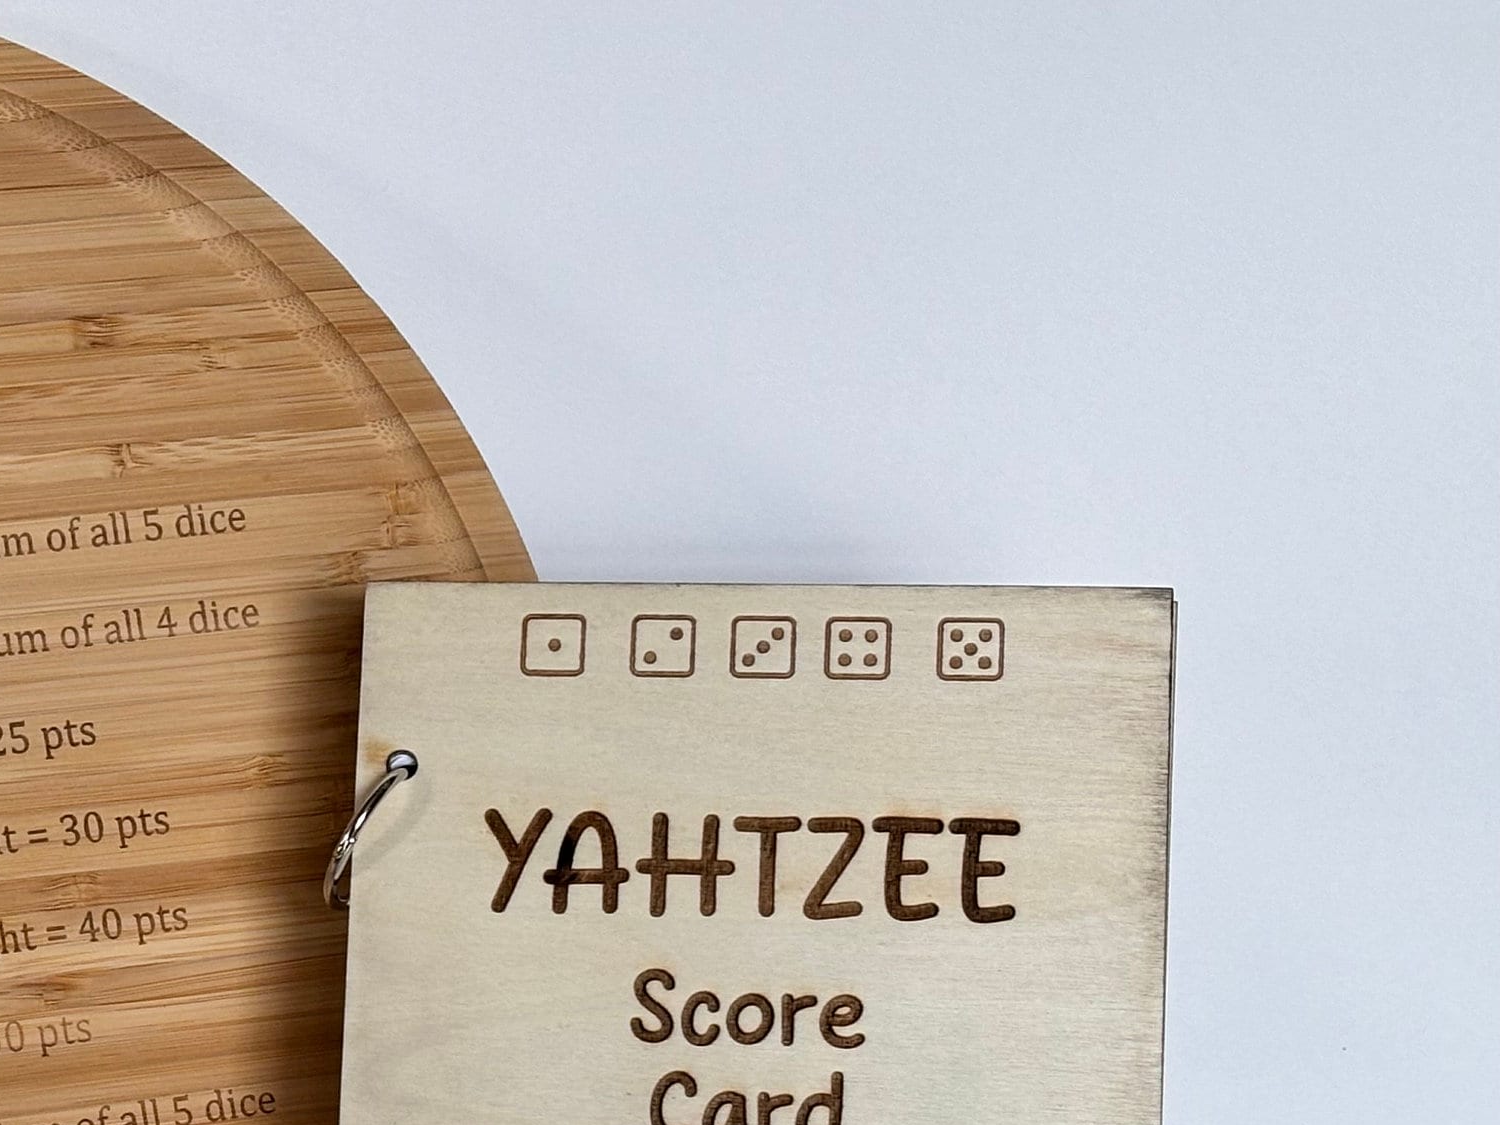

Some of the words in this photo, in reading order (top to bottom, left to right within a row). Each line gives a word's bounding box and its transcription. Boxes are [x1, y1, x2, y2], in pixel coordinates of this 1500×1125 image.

[46, 518, 82, 553] of
[91, 513, 132, 547] all
[144, 508, 164, 542] 5
[175, 503, 248, 537] dice
[60, 614, 96, 649] of
[104, 608, 145, 644] all
[157, 606, 178, 638] 4
[188, 600, 261, 634] dice
[41, 718, 98, 760] pts
[28, 827, 49, 844] =
[59, 811, 104, 848] 30
[115, 807, 171, 848] pts
[484, 808, 1021, 923] YAHTZEE
[46, 925, 68, 943] =
[78, 908, 123, 943] 40
[134, 904, 190, 944] pts
[630, 968, 866, 1049] Score
[37, 1016, 93, 1057] pts
[205, 1089, 277, 1124] dice
